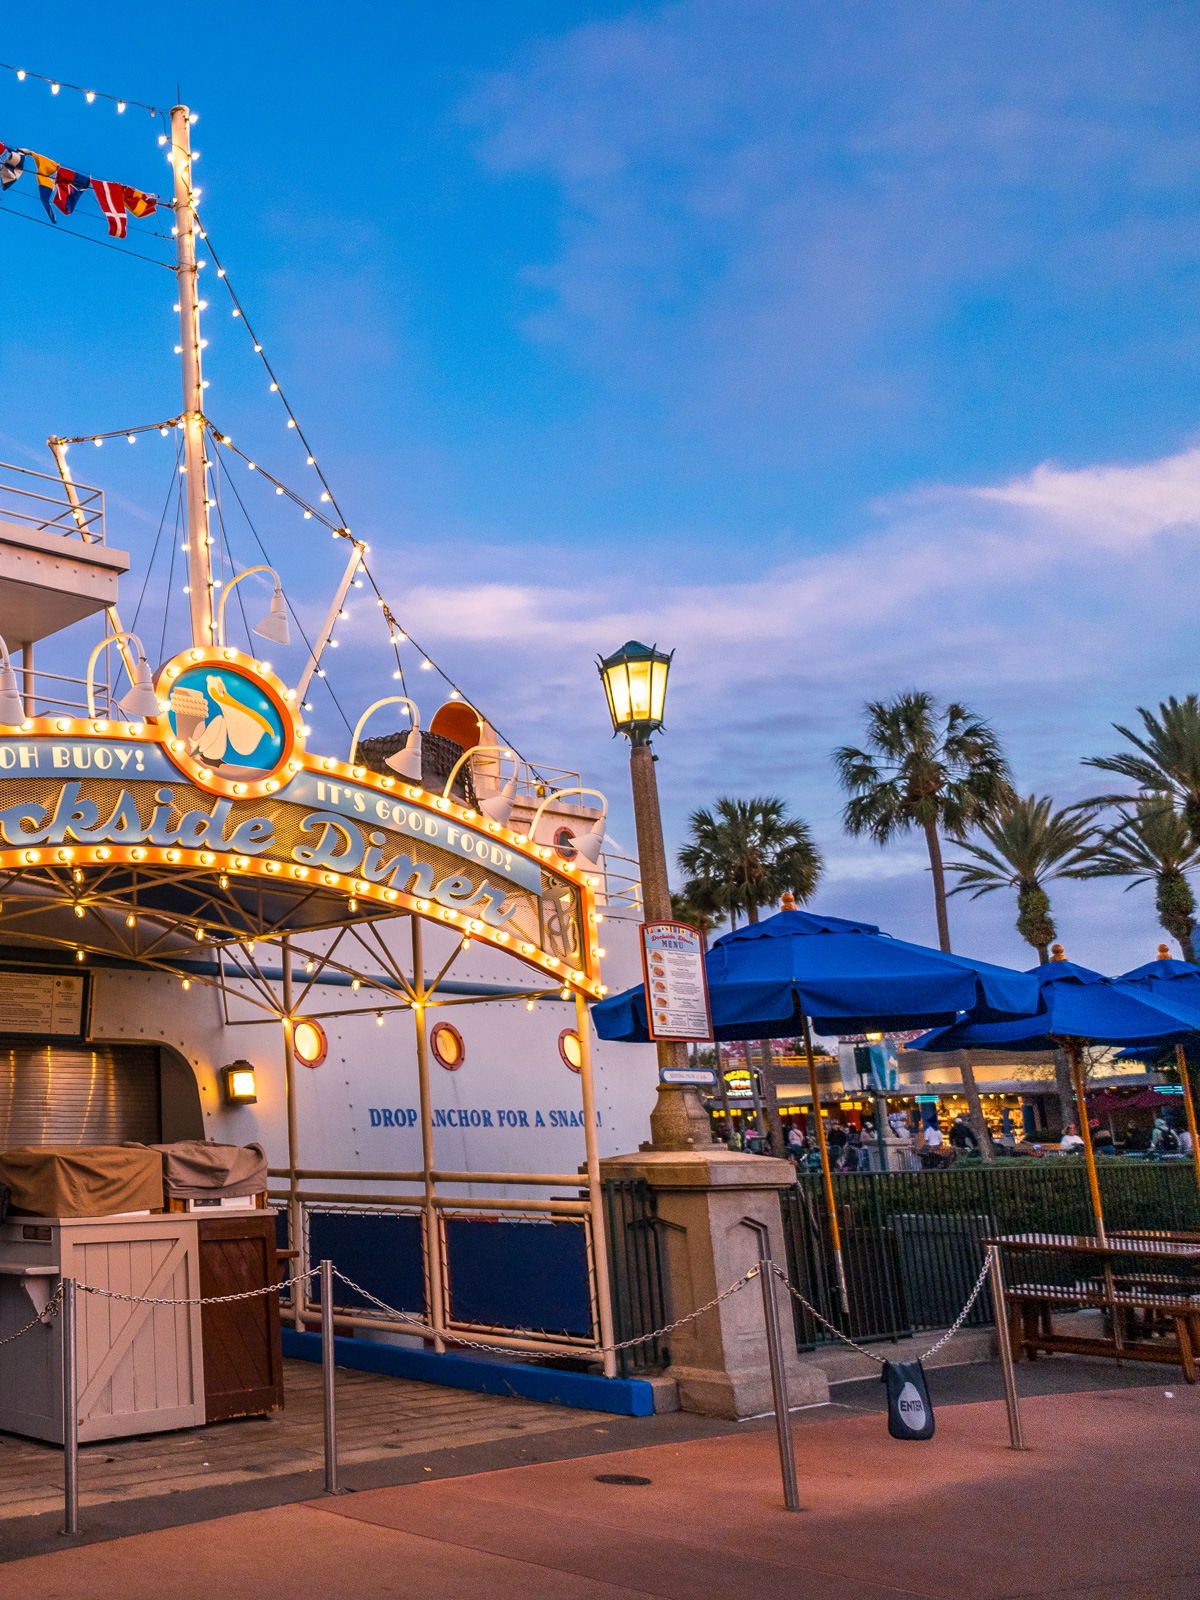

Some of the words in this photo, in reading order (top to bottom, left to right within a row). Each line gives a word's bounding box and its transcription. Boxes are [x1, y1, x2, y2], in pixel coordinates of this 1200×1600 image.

[52, 746, 145, 771] BUOY!
[316, 781, 366, 812] IT'S
[376, 800, 438, 837] GOOD
[446, 827, 513, 872] FOOD!
[291, 812, 516, 926] Diner
[661, 940, 683, 949] MENU
[368, 1108, 417, 1127] DROP
[432, 1108, 493, 1127] NCHOR
[497, 1110, 529, 1127] FOR
[535, 1110, 546, 1127] A
[549, 1110, 602, 1127] SNAC!
